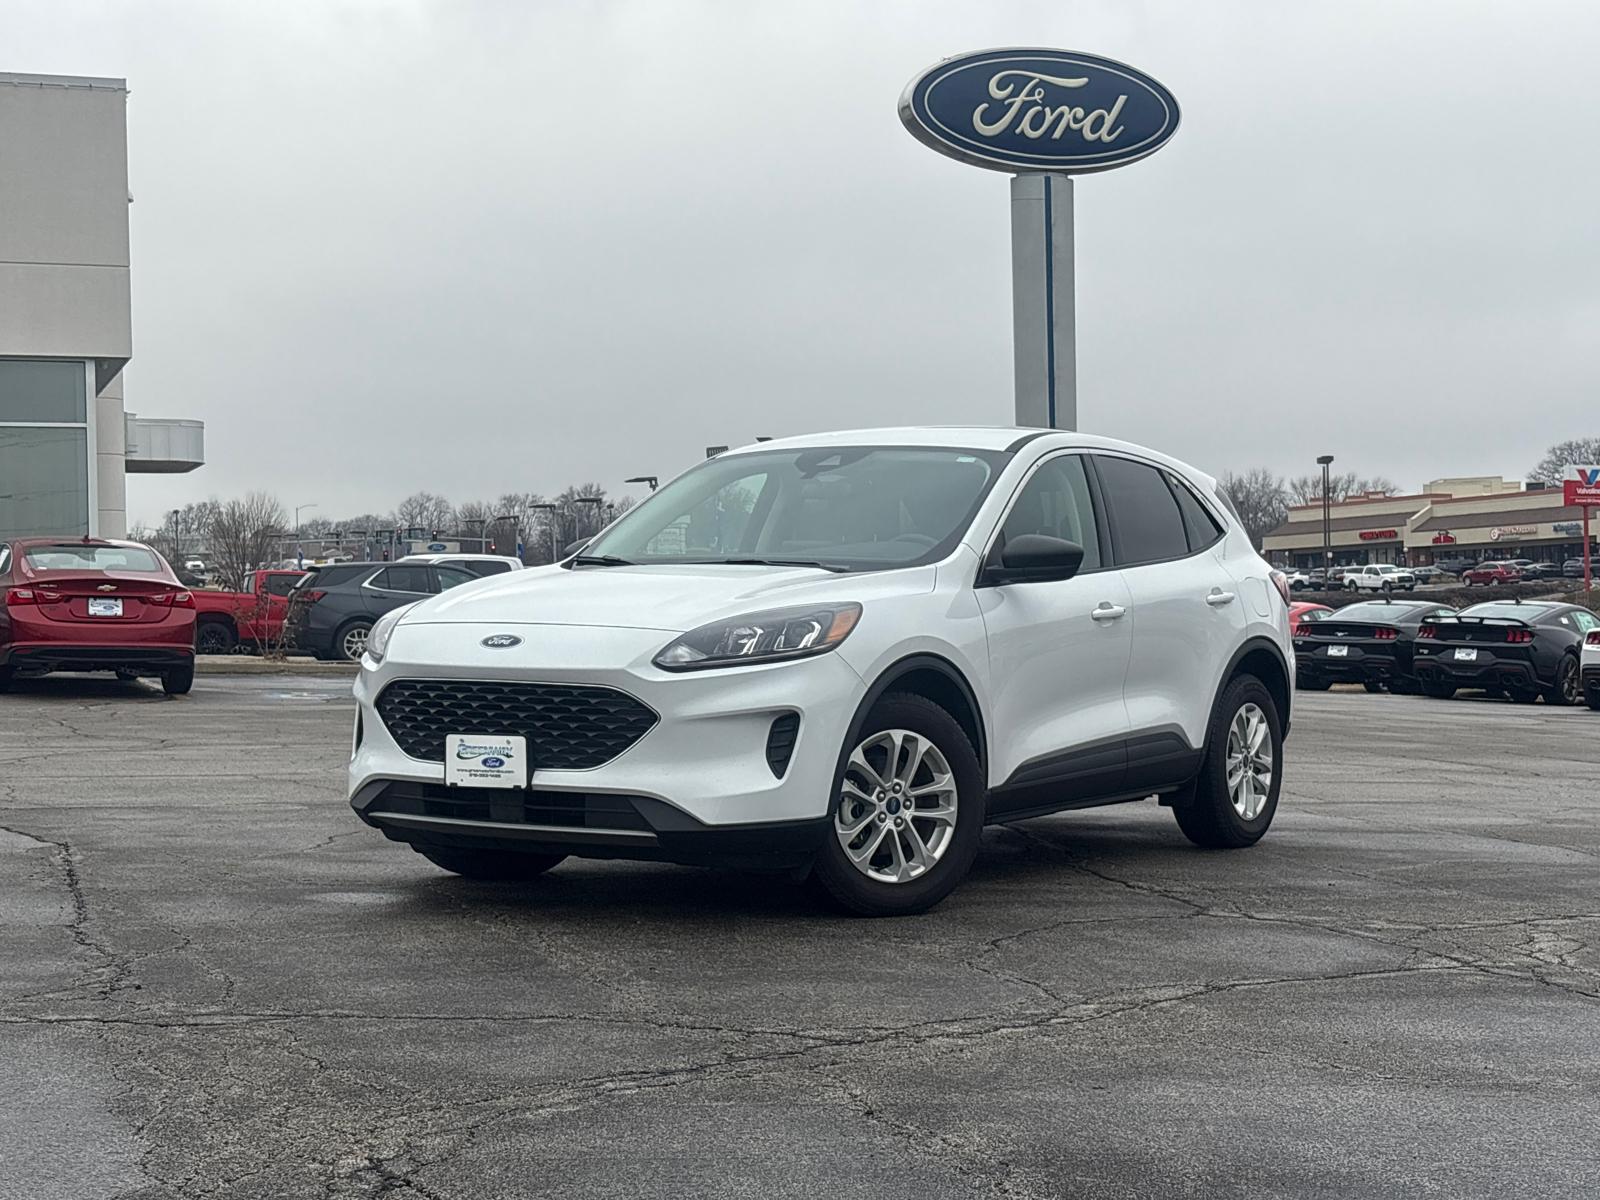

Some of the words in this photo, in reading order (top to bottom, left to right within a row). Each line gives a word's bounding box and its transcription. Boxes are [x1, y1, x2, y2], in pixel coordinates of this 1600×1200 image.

[973, 70, 1128, 143] Ford
[488, 635, 514, 645] Ford
[485, 758, 500, 767] Ford
